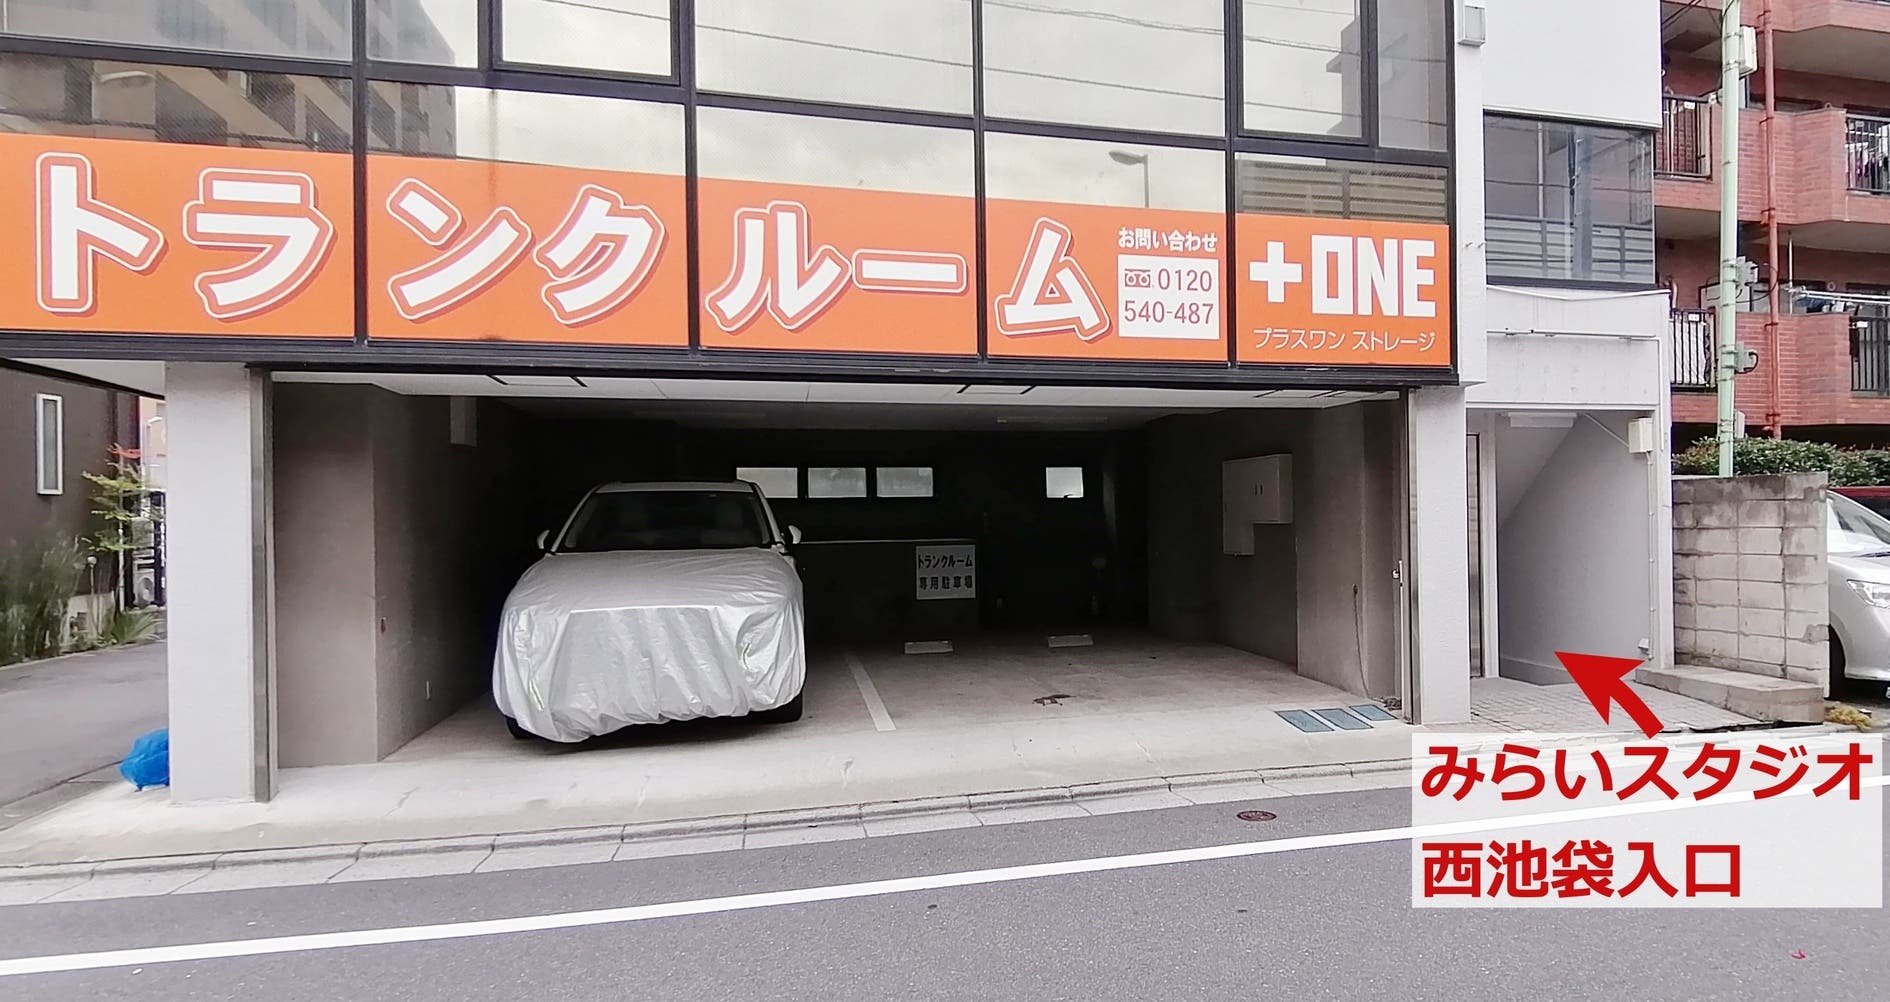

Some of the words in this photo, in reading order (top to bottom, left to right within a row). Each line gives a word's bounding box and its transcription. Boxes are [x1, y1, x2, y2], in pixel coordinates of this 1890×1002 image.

[36, 152, 1111, 341] トランクルーム
[1118, 227, 1218, 252] お問い合わせ
[1157, 268, 1213, 292] 0120
[1124, 300, 1214, 325] 540-487
[1253, 327, 1345, 350] プラスワン
[1352, 330, 1436, 352] ストレージ
[918, 554, 973, 569] トランクルーム
[919, 575, 973, 590] 専用駐車場
